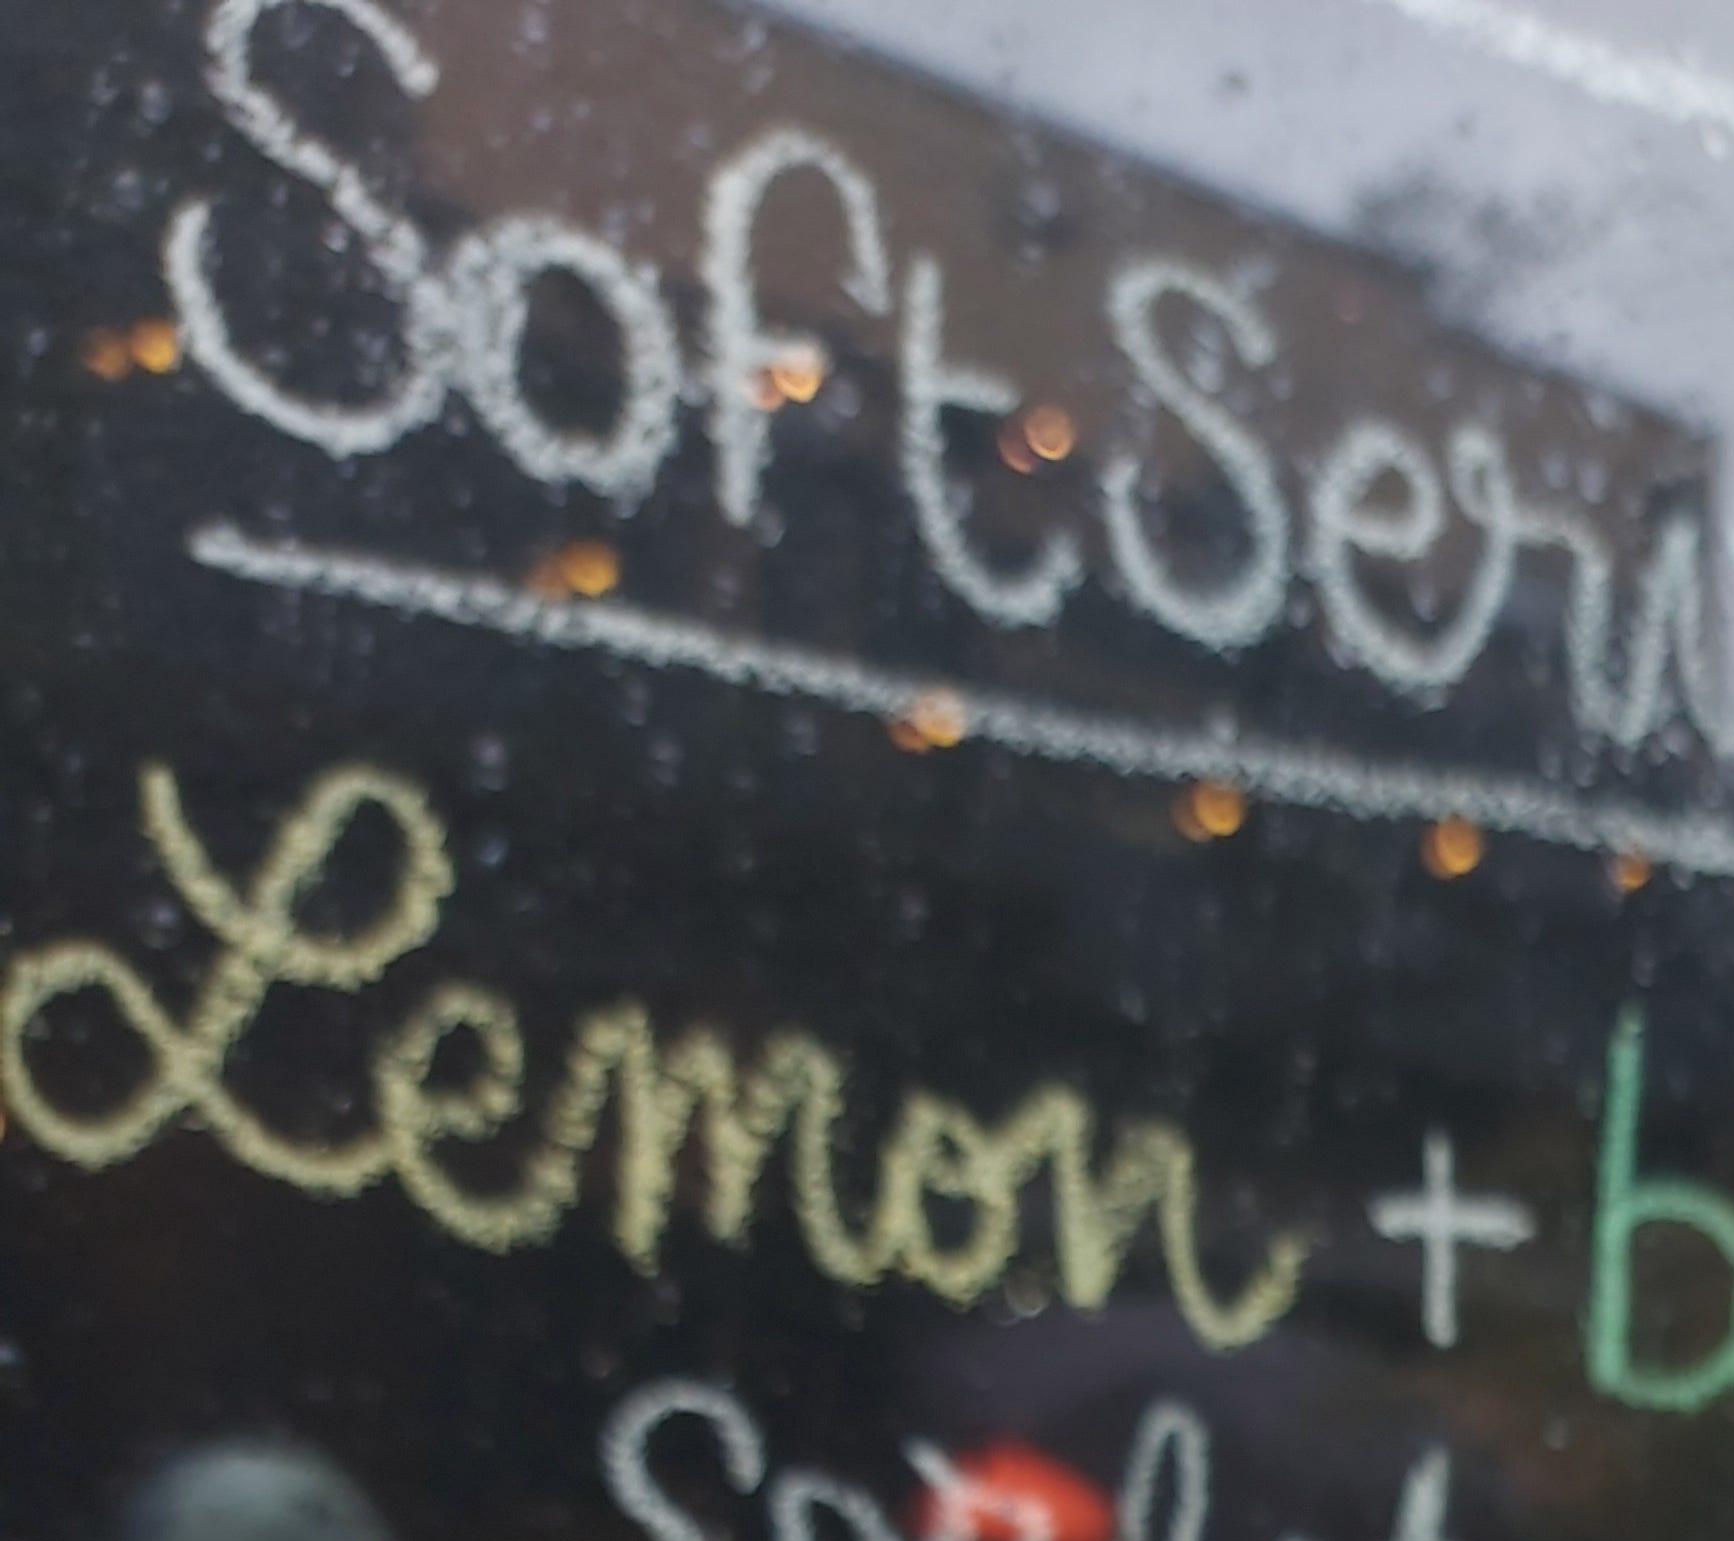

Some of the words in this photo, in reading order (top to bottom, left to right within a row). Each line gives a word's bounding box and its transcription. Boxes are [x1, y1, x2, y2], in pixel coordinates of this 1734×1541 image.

[163, 0, 1085, 628] Soft
[0, 762, 1310, 1350] Lemon
[1368, 1125, 1538, 1352] +
